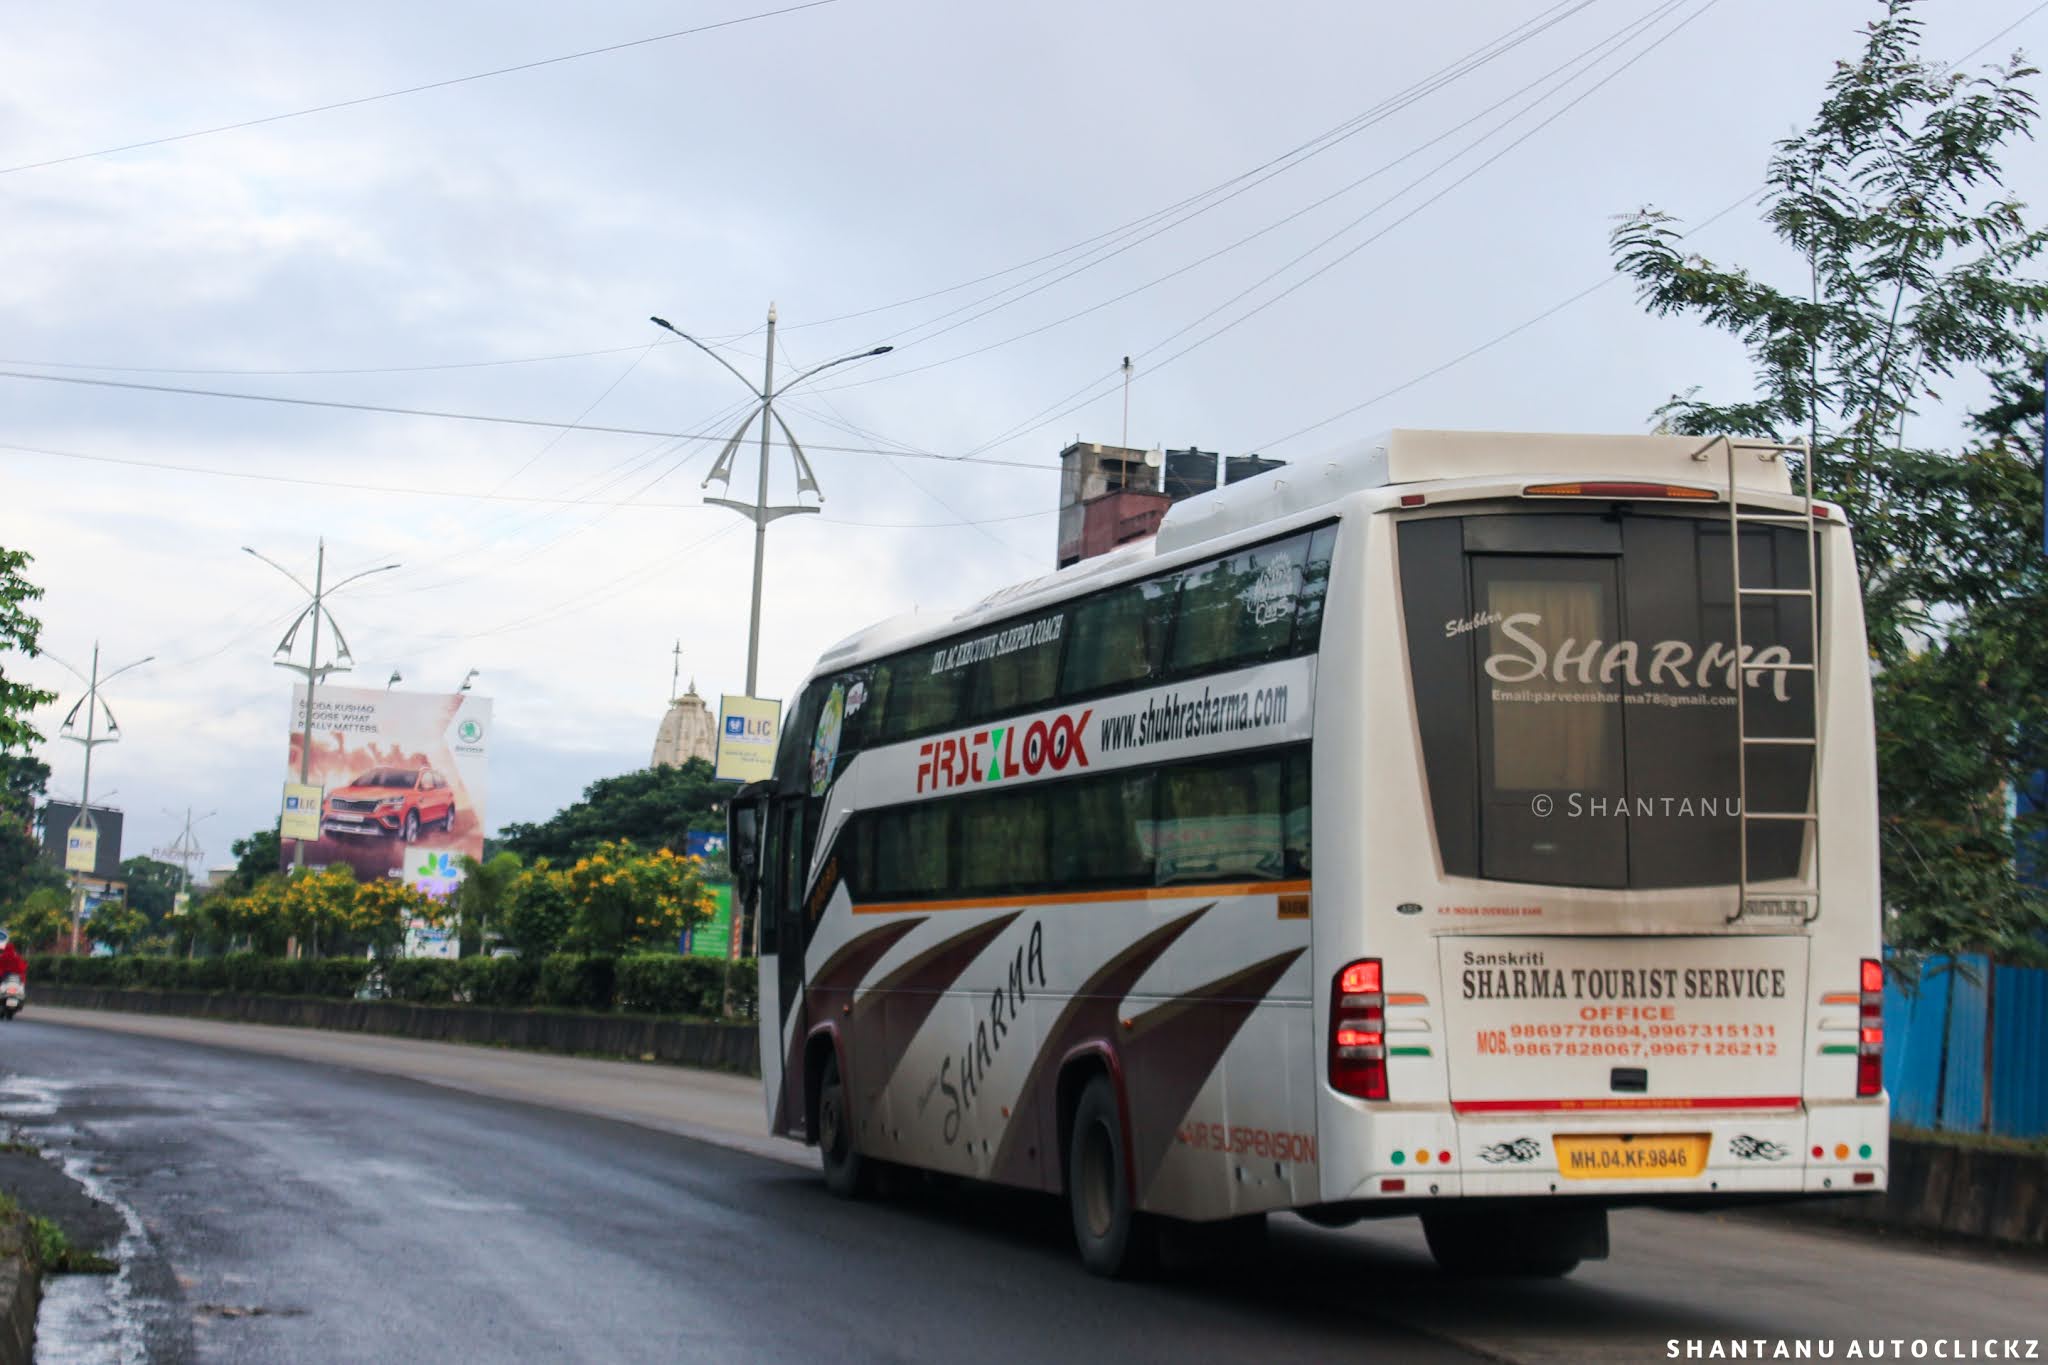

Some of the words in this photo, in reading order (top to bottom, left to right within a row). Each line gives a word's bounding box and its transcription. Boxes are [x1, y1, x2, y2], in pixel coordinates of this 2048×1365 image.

[1445, 611, 1501, 638] Shubhra
[944, 645, 958, 671] AC
[956, 633, 999, 667] EXECUTIVE
[996, 622, 1034, 656] SLEEPER
[1032, 613, 1064, 646] COACH
[1484, 612, 1792, 702] SHARMA
[298, 720, 332, 730] RALLY
[299, 711, 339, 720] COOSE
[343, 714, 371, 722] WHAT
[748, 719, 772, 736] LIC
[1100, 685, 1288, 752] www.shubhrasharma.com
[1004, 709, 1094, 778] LOOK
[300, 798, 316, 810] LIC
[1464, 951, 1544, 966] Sanskriti
[1463, 968, 1567, 999] SHARMA
[1572, 968, 1678, 999] TOURIST
[1685, 968, 1785, 999] SERVICE
[1580, 1006, 1676, 1021] OFFICE
[940, 920, 1046, 1146] SHARMA
[1477, 1031, 1510, 1055] MOB.
[1211, 1122, 1316, 1164] SUSPENSION
[1571, 1149, 1687, 1169] MH.04.KF.9846
